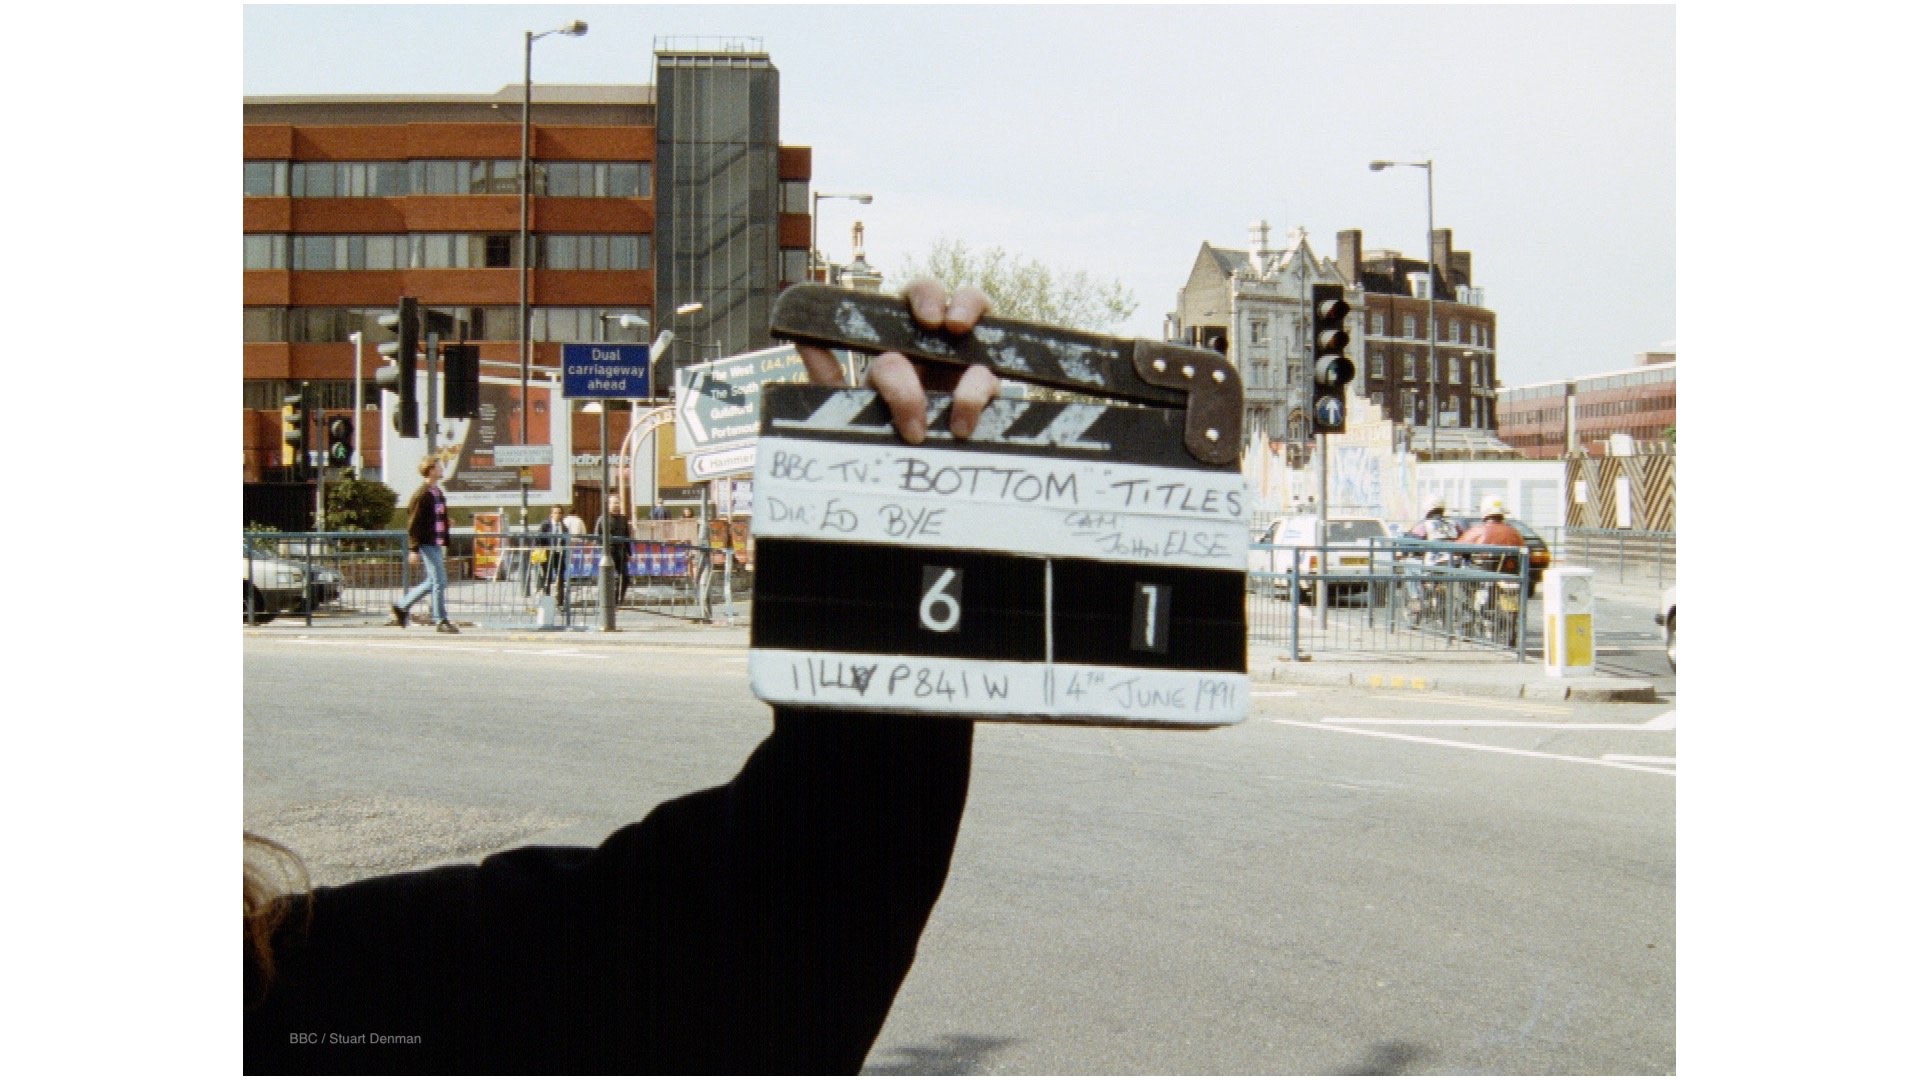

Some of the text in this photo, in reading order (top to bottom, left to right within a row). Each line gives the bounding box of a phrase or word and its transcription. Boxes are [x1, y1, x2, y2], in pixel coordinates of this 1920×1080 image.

[591, 348, 621, 361] Dual
[568, 364, 645, 377] carriageway
[711, 369, 727, 381] The
[730, 363, 754, 377] West
[587, 378, 626, 390] ahead
[710, 388, 728, 401] The
[711, 402, 753, 419] Guildford
[711, 419, 760, 439] Portsmout
[710, 453, 754, 471] Hammer
[770, 451, 823, 482] BBC
[820, 499, 858, 532] ED
[878, 503, 946, 538] BYE
[919, 567, 962, 632] 6
[1141, 585, 1157, 647] 1
[1108, 676, 1185, 709] JUNE
[1194, 678, 1236, 712] 1991
